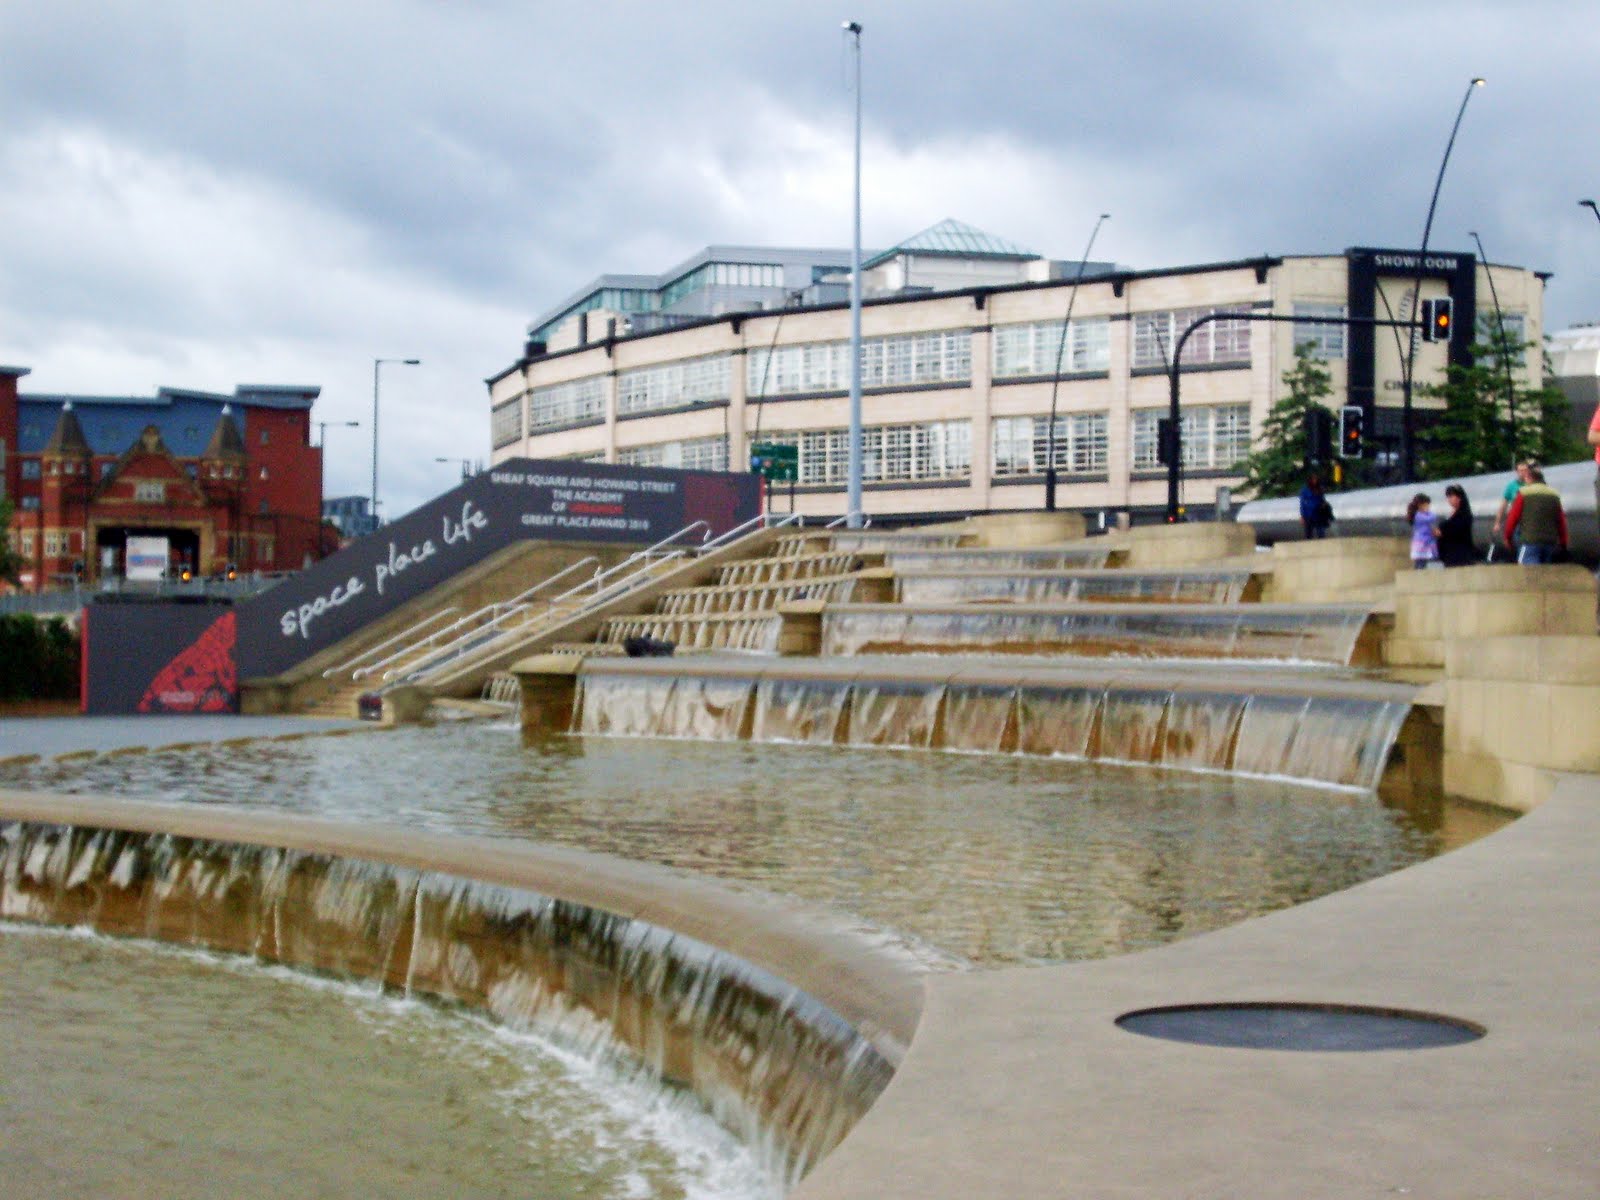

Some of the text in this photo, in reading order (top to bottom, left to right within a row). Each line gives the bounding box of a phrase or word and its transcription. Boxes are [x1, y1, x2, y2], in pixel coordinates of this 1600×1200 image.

[527, 474, 568, 487] SQUARE
[569, 477, 592, 488] AND
[593, 478, 639, 490] HOWARD
[641, 481, 677, 493] STREET
[552, 488, 623, 503] THE ACADEMY
[551, 501, 567, 512] OF
[521, 513, 555, 525] GREAT
[556, 515, 590, 528] PLACE
[590, 517, 627, 529] AWARD
[280, 500, 489, 640] space place life
